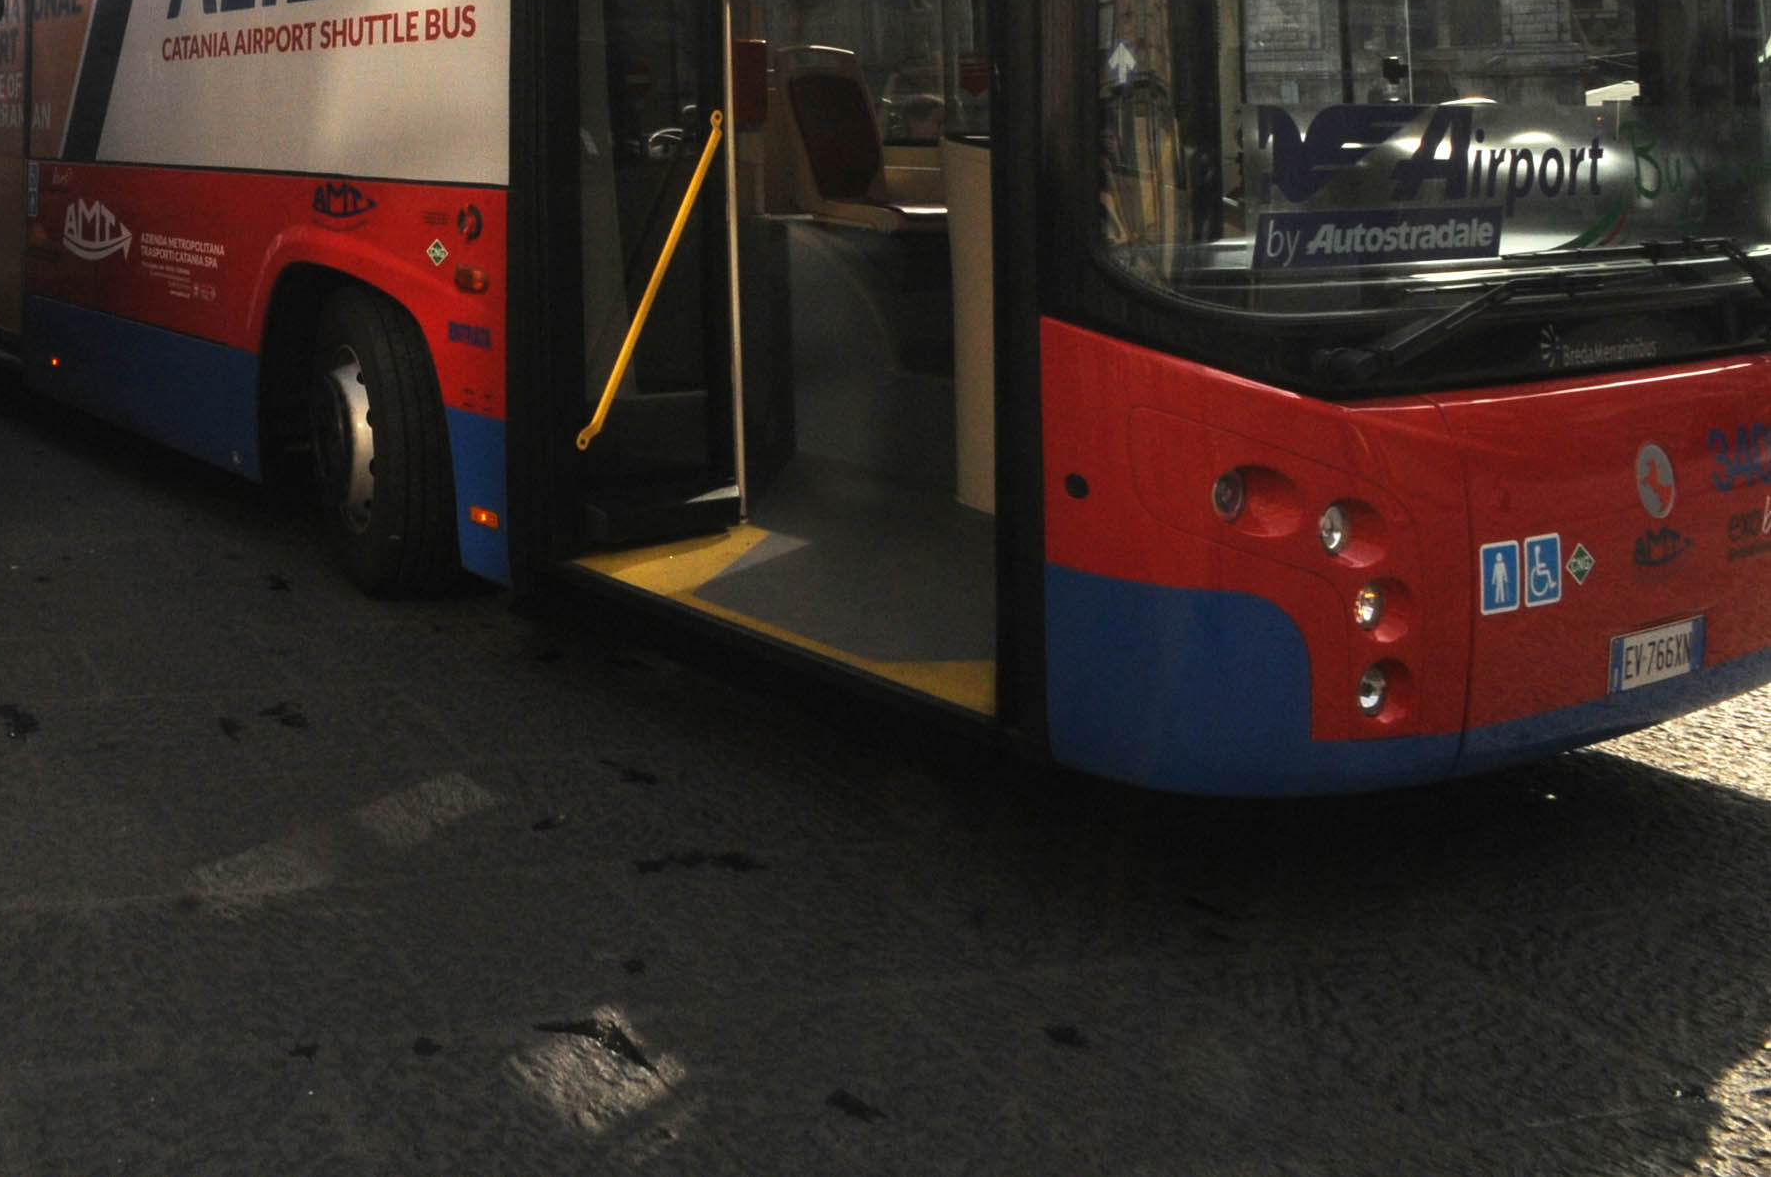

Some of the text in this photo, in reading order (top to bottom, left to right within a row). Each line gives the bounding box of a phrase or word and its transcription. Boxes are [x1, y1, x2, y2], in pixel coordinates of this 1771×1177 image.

[162, 4, 475, 61] CATANIA AIRPORT SHUTTLE BUS
[1388, 105, 1603, 219] Airport
[64, 198, 118, 243] AMT
[1265, 218, 1493, 267] by Autostradale
[1562, 339, 1658, 366] BredaMenarinibus
